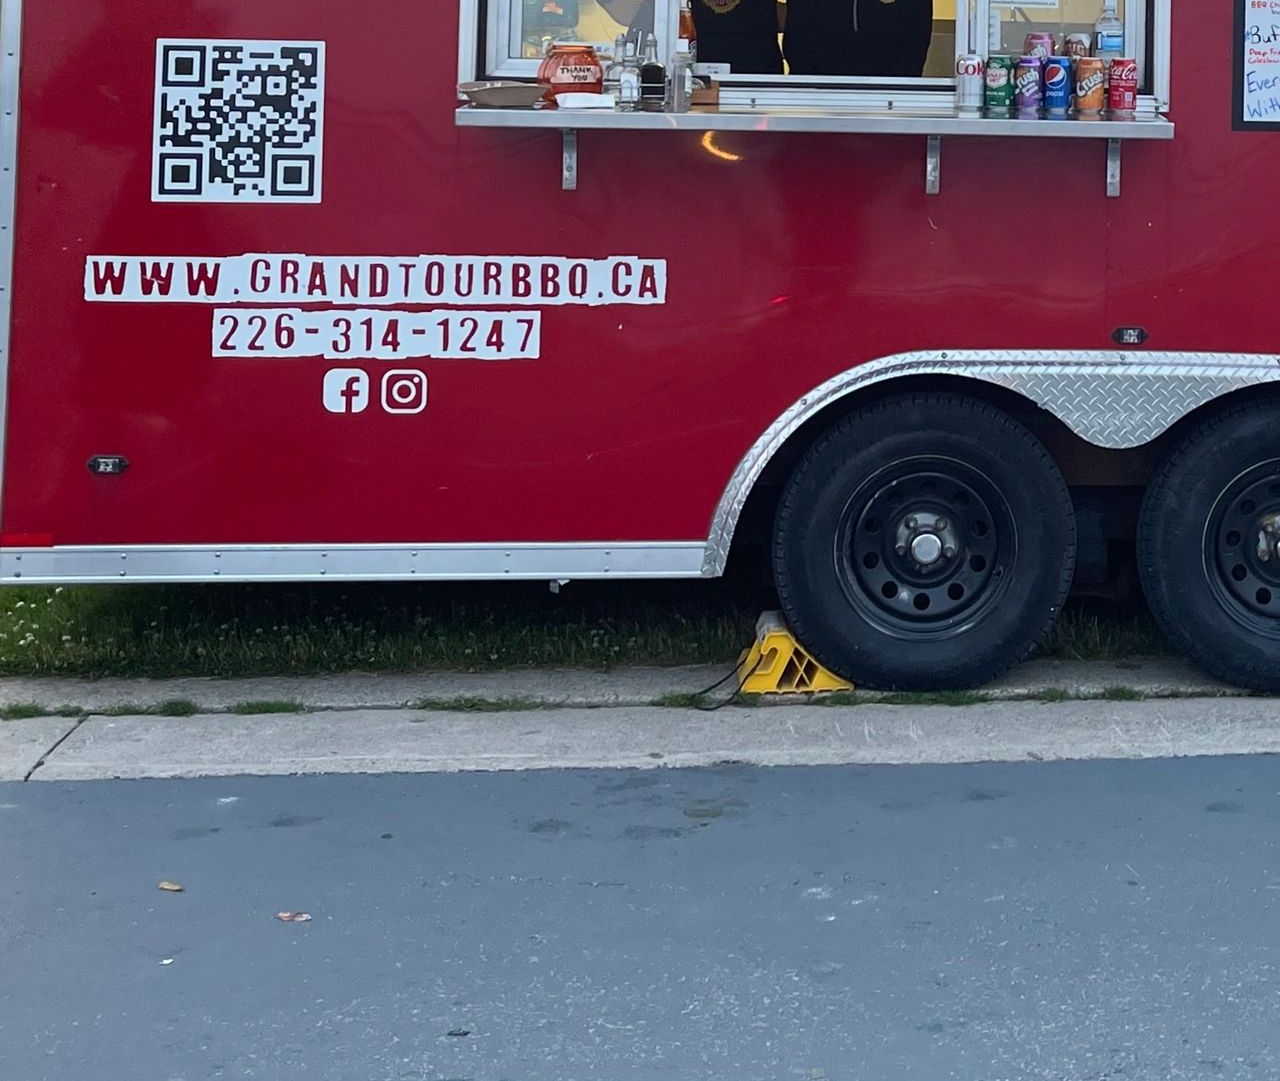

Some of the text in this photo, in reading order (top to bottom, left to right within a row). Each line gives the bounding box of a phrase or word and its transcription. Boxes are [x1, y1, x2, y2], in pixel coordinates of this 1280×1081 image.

[559, 66, 593, 75] THANK
[956, 59, 984, 76] Cok
[571, 73, 588, 82] YOU
[1076, 70, 1104, 97] Crush
[1045, 89, 1065, 98] pepsi
[91, 257, 660, 300] WWW.GRANDTOURBBQ.CA
[217, 312, 536, 354] 226-314-1247
